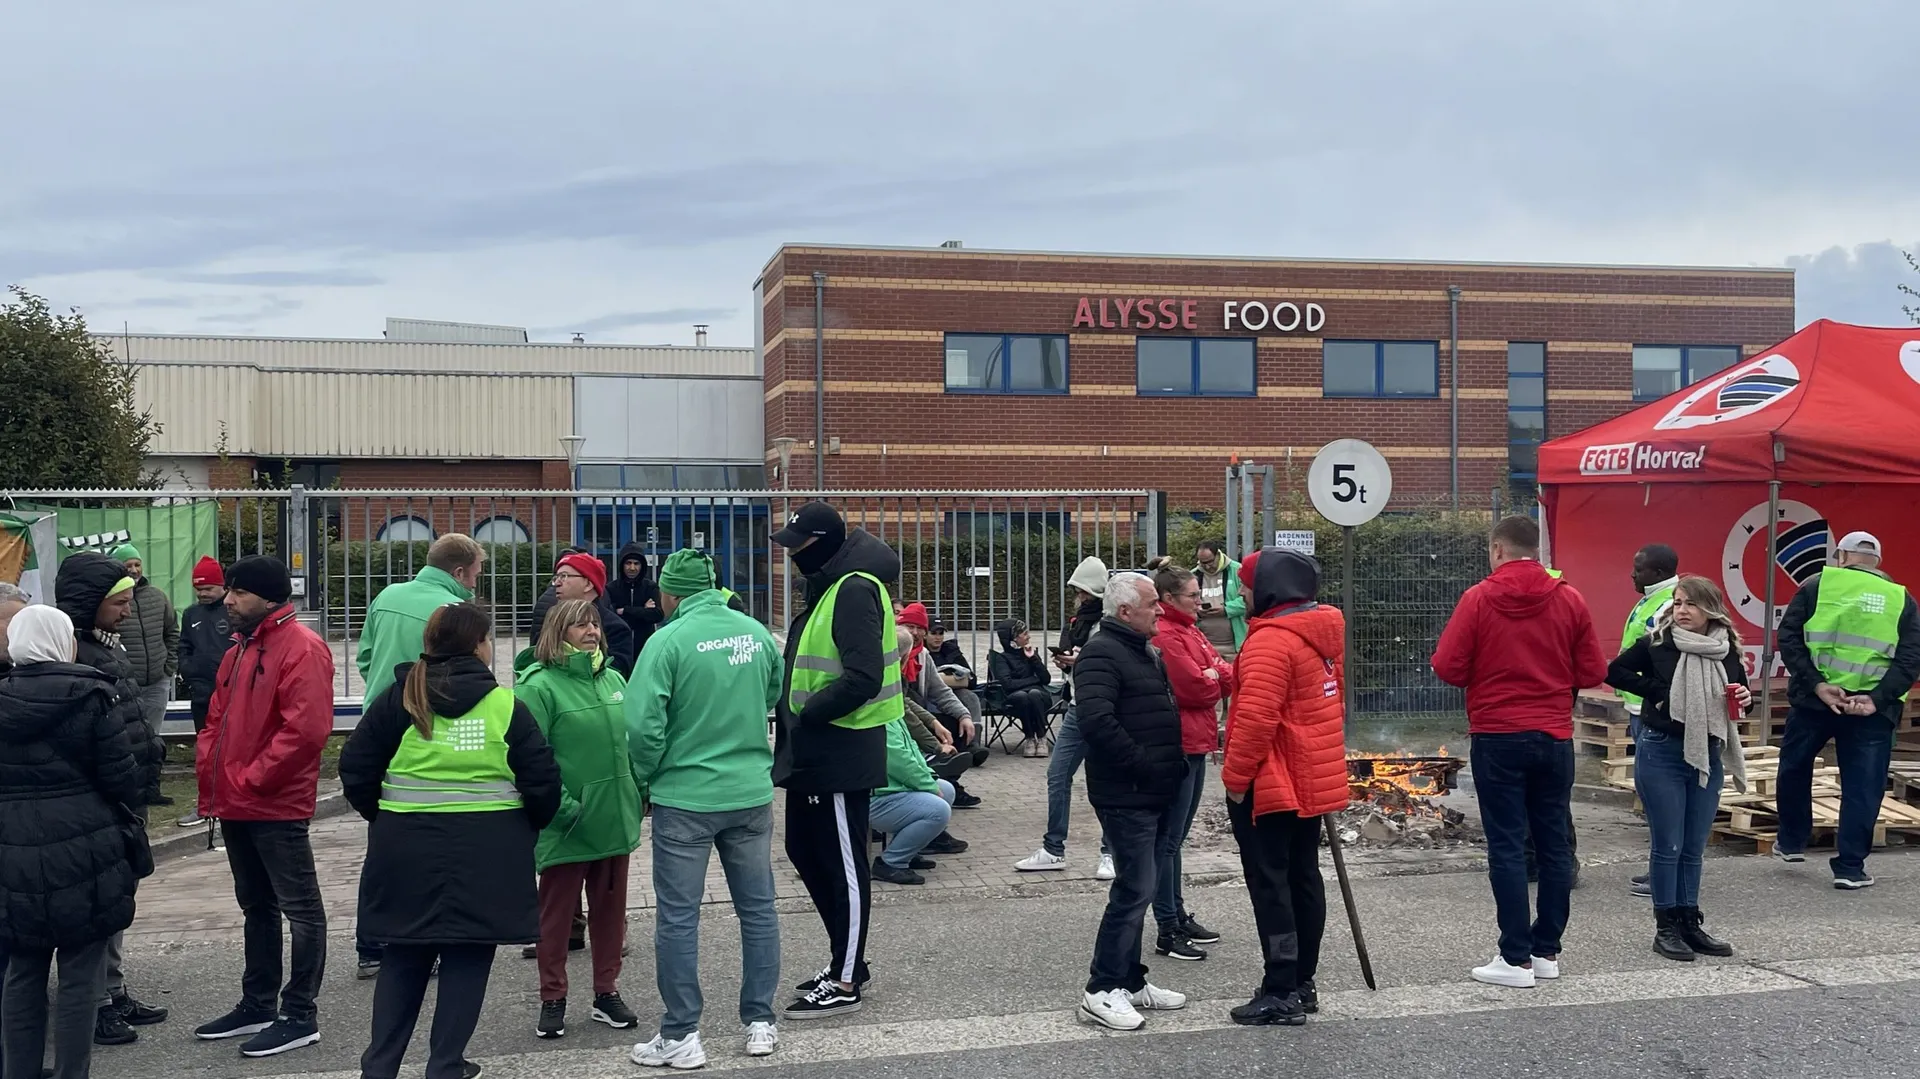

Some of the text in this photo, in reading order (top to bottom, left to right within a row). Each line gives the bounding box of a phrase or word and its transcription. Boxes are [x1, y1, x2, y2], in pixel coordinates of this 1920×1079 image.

[1072, 297, 1326, 332] ALYSSE FOOD
[1584, 445, 1706, 471] FGTB Horval
[696, 634, 754, 652] ORGANIZE
[733, 641, 763, 656] FIGHT
[727, 652, 753, 666] WIN
